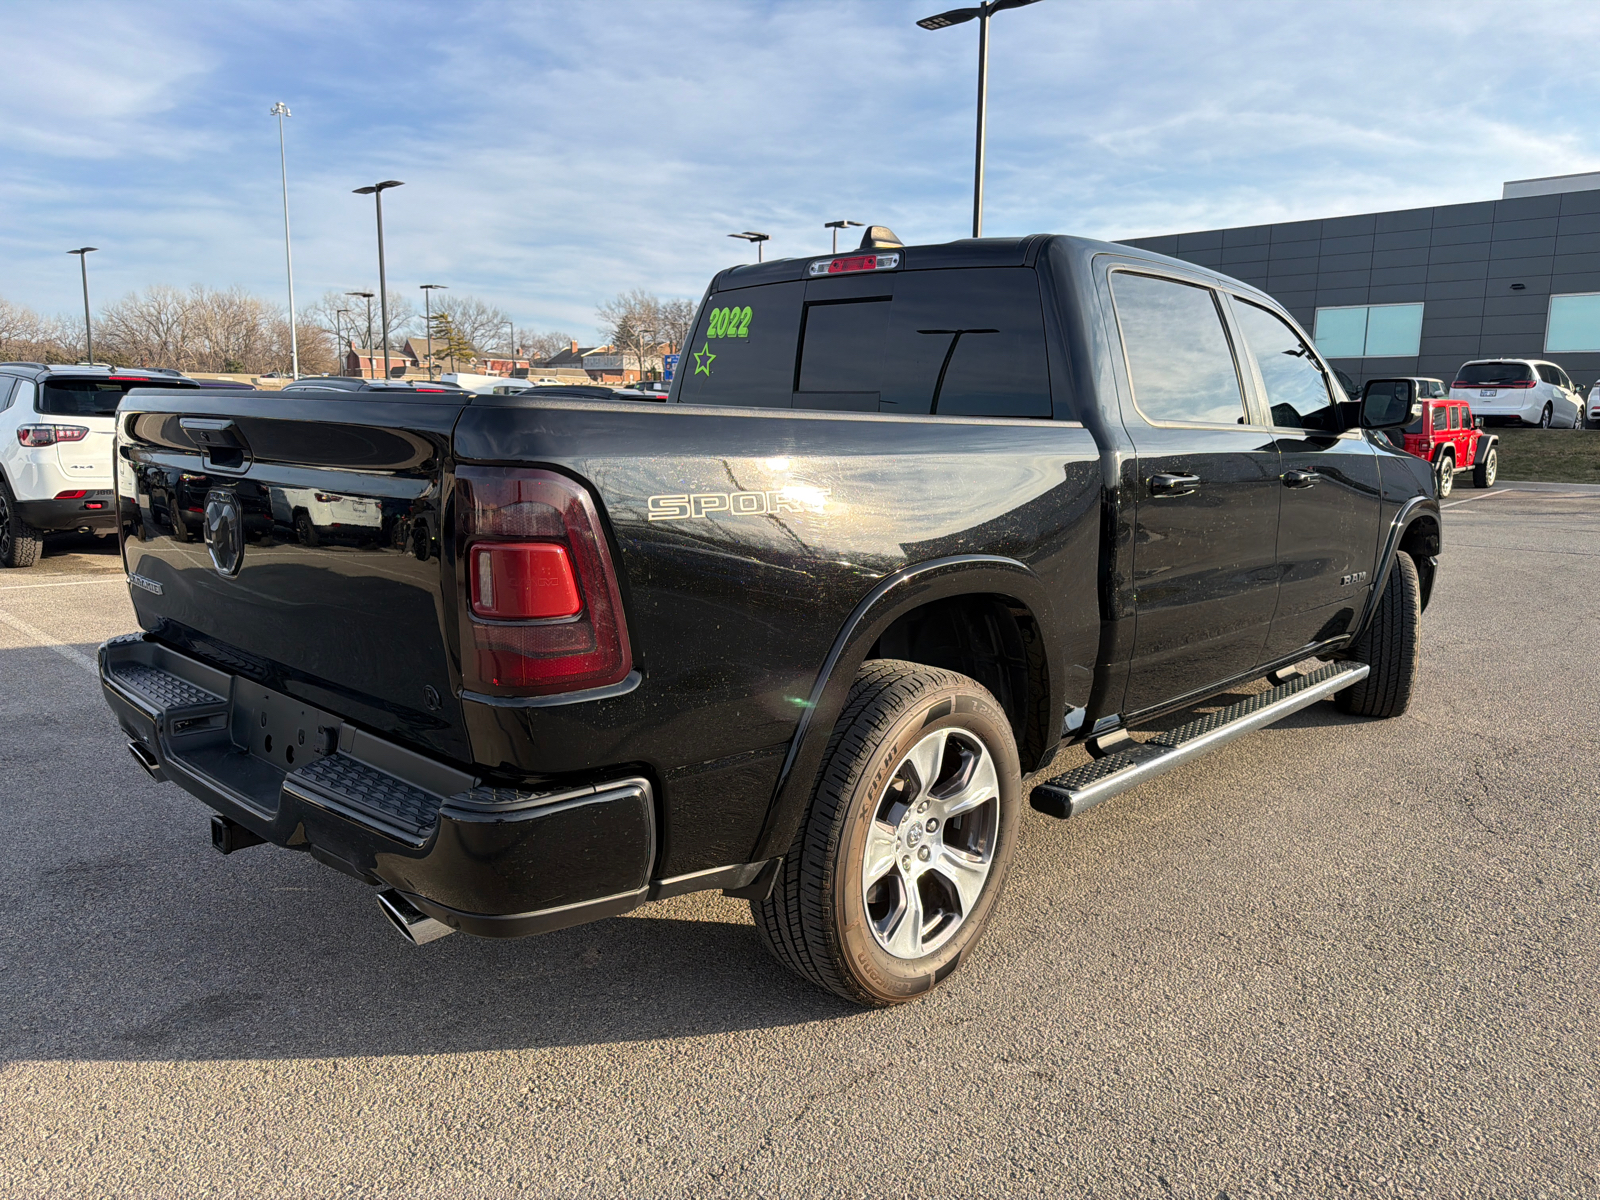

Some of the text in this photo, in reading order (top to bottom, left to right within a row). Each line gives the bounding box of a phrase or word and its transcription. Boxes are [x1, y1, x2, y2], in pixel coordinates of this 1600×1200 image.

[706, 305, 753, 338] 2022
[1340, 571, 1367, 587] RAM
[858, 742, 900, 824] X FIT HT
